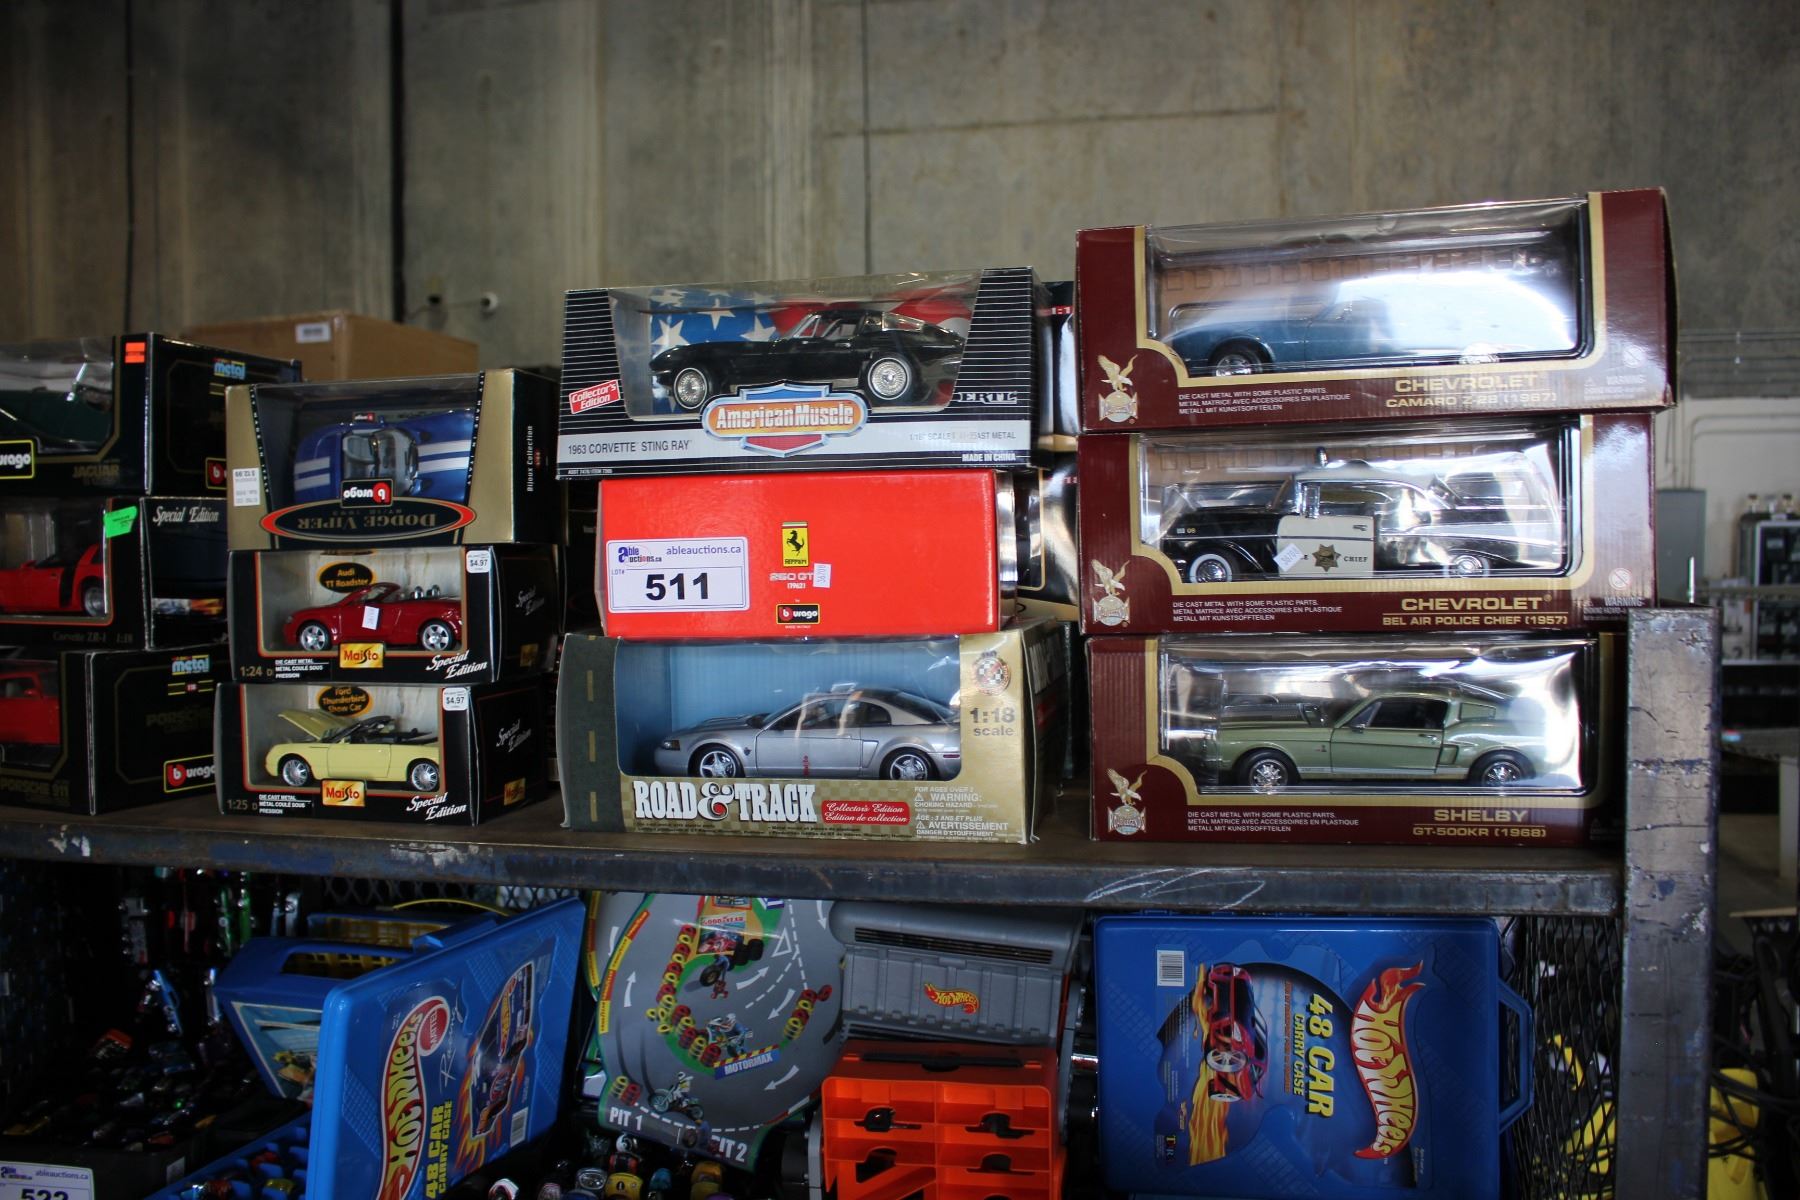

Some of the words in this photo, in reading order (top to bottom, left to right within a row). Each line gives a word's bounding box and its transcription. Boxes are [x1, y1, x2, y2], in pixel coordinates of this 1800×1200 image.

[1395, 374, 1538, 393] CHEVROLET
[571, 382, 618, 404] Collector's
[1232, 398, 1251, 406] AVEC
[1251, 396, 1300, 404] ACCESSOIRES
[1312, 393, 1351, 402] PLASTIQUE
[1252, 389, 1272, 397] SOME
[1273, 388, 1302, 396] PLASTIC
[580, 394, 611, 410] Edition
[1385, 395, 1457, 409] CAMARO
[716, 404, 794, 429] American
[794, 403, 854, 427] Muscle
[991, 431, 1017, 440] METAL
[525, 425, 535, 466] Collection
[568, 445, 587, 455] 1963
[588, 442, 636, 454] CORVETTE
[641, 441, 669, 453] STING
[671, 440, 690, 451] RAY
[0, 452, 32, 469] urago
[961, 454, 983, 463] MADE
[984, 454, 993, 462] IN
[993, 453, 1017, 462] CHINA
[525, 466, 535, 492] Bijoux
[343, 485, 388, 501] burago
[153, 506, 185, 522] Special
[189, 506, 219, 523] Edition
[363, 513, 436, 528] DODGE
[297, 516, 357, 530] VIPER
[666, 545, 741, 556] ableauctions.ca
[469, 559, 488, 567] $4.97
[337, 568, 355, 577] Audi
[769, 572, 797, 582] 250
[326, 580, 335, 588] TT
[335, 578, 369, 588] Roadster
[645, 572, 710, 601] 511
[1401, 597, 1543, 611] CHEVROLET
[782, 608, 818, 619] burago
[1382, 617, 1407, 626] BEL
[1410, 617, 1431, 626] AIR
[1435, 616, 1481, 626] POLICE
[1483, 616, 1521, 625] CHIEF
[1524, 615, 1568, 625] (1957)
[343, 647, 380, 666] Maisto
[426, 650, 469, 672] Special
[239, 665, 263, 677] 1:24
[444, 661, 488, 680] Edition
[446, 696, 465, 705] $4.97
[969, 707, 1016, 724] 1:18
[973, 725, 1015, 737] scale
[326, 786, 361, 803] Maisto
[406, 792, 449, 813] Special
[633, 780, 698, 820] ROAD
[697, 781, 735, 822] &
[733, 783, 818, 823] TRACK
[930, 793, 983, 802] WARNING:
[226, 799, 248, 810] 1:25
[425, 803, 467, 821] Edition
[826, 802, 870, 813] Collector's
[873, 803, 905, 814] Edition
[856, 813, 866, 822] de
[867, 813, 908, 823] collection
[1320, 819, 1360, 827] PLASTIQUE
[1433, 809, 1529, 823] SHELBY
[928, 821, 1009, 831] AVERTISSEMENT
[1412, 826, 1489, 838] GT-500KR
[1494, 827, 1548, 839] (1968)
[1307, 993, 1334, 1039] 48
[1293, 1013, 1305, 1059] CARRY
[724, 1052, 773, 1076] MOTORMAX
[1293, 1060, 1305, 1097] CASE
[1307, 1045, 1335, 1118] CAR
[441, 1100, 453, 1141] CASE
[609, 1106, 632, 1127] PIT
[635, 1115, 642, 1131] 1
[428, 1105, 444, 1158] CAR
[735, 1143, 748, 1163] 2
[35, 1169, 89, 1180] ableauctions.ca
[438, 1143, 449, 1194] CARRY
[425, 1162, 439, 1200] 48
